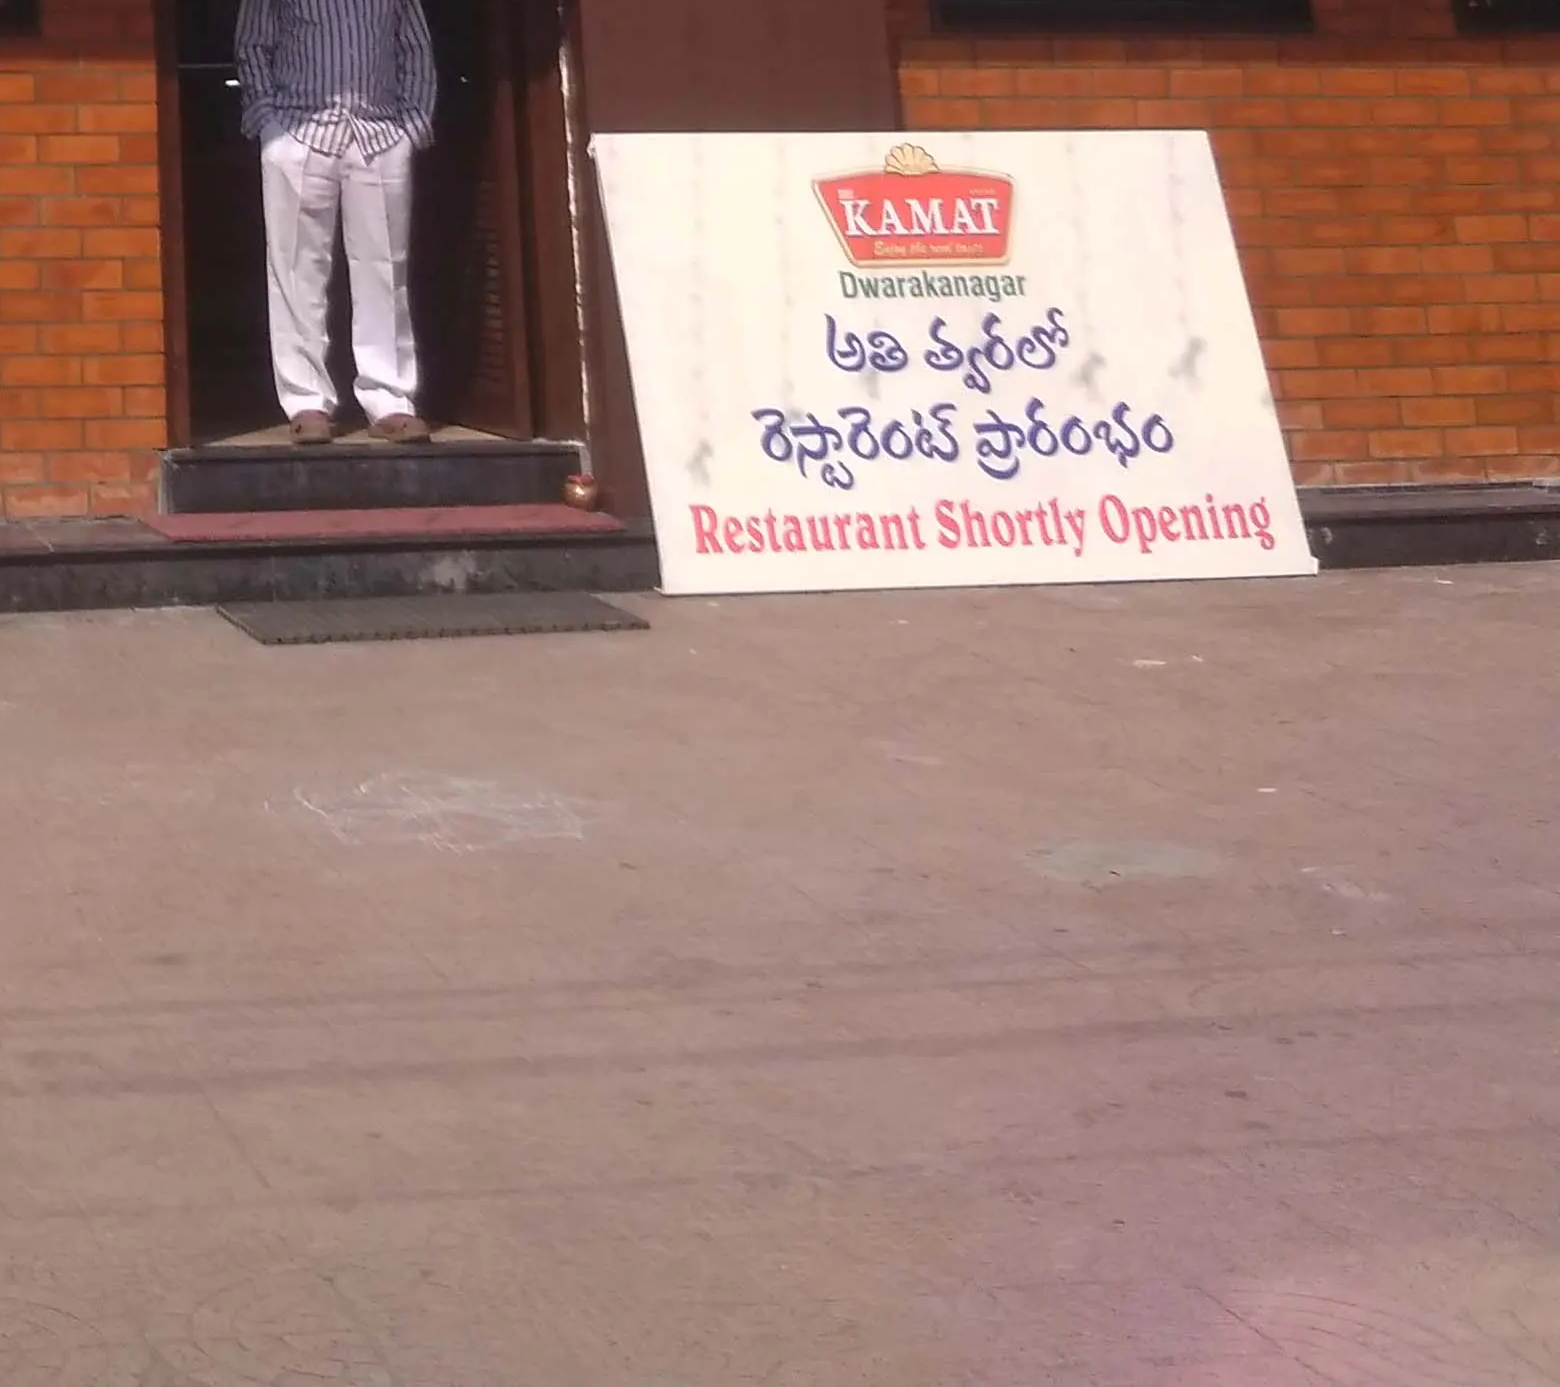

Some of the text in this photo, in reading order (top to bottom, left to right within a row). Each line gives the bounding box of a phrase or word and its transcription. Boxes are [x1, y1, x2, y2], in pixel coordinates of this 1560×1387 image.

[840, 197, 1001, 236] KAMAT
[838, 270, 1026, 302] Dwarakanagar
[824, 307, 1069, 393] అతి త్వరలో
[973, 397, 1174, 479] ప్రారంభం
[689, 493, 1276, 557] Restaurant Shortly Opening
